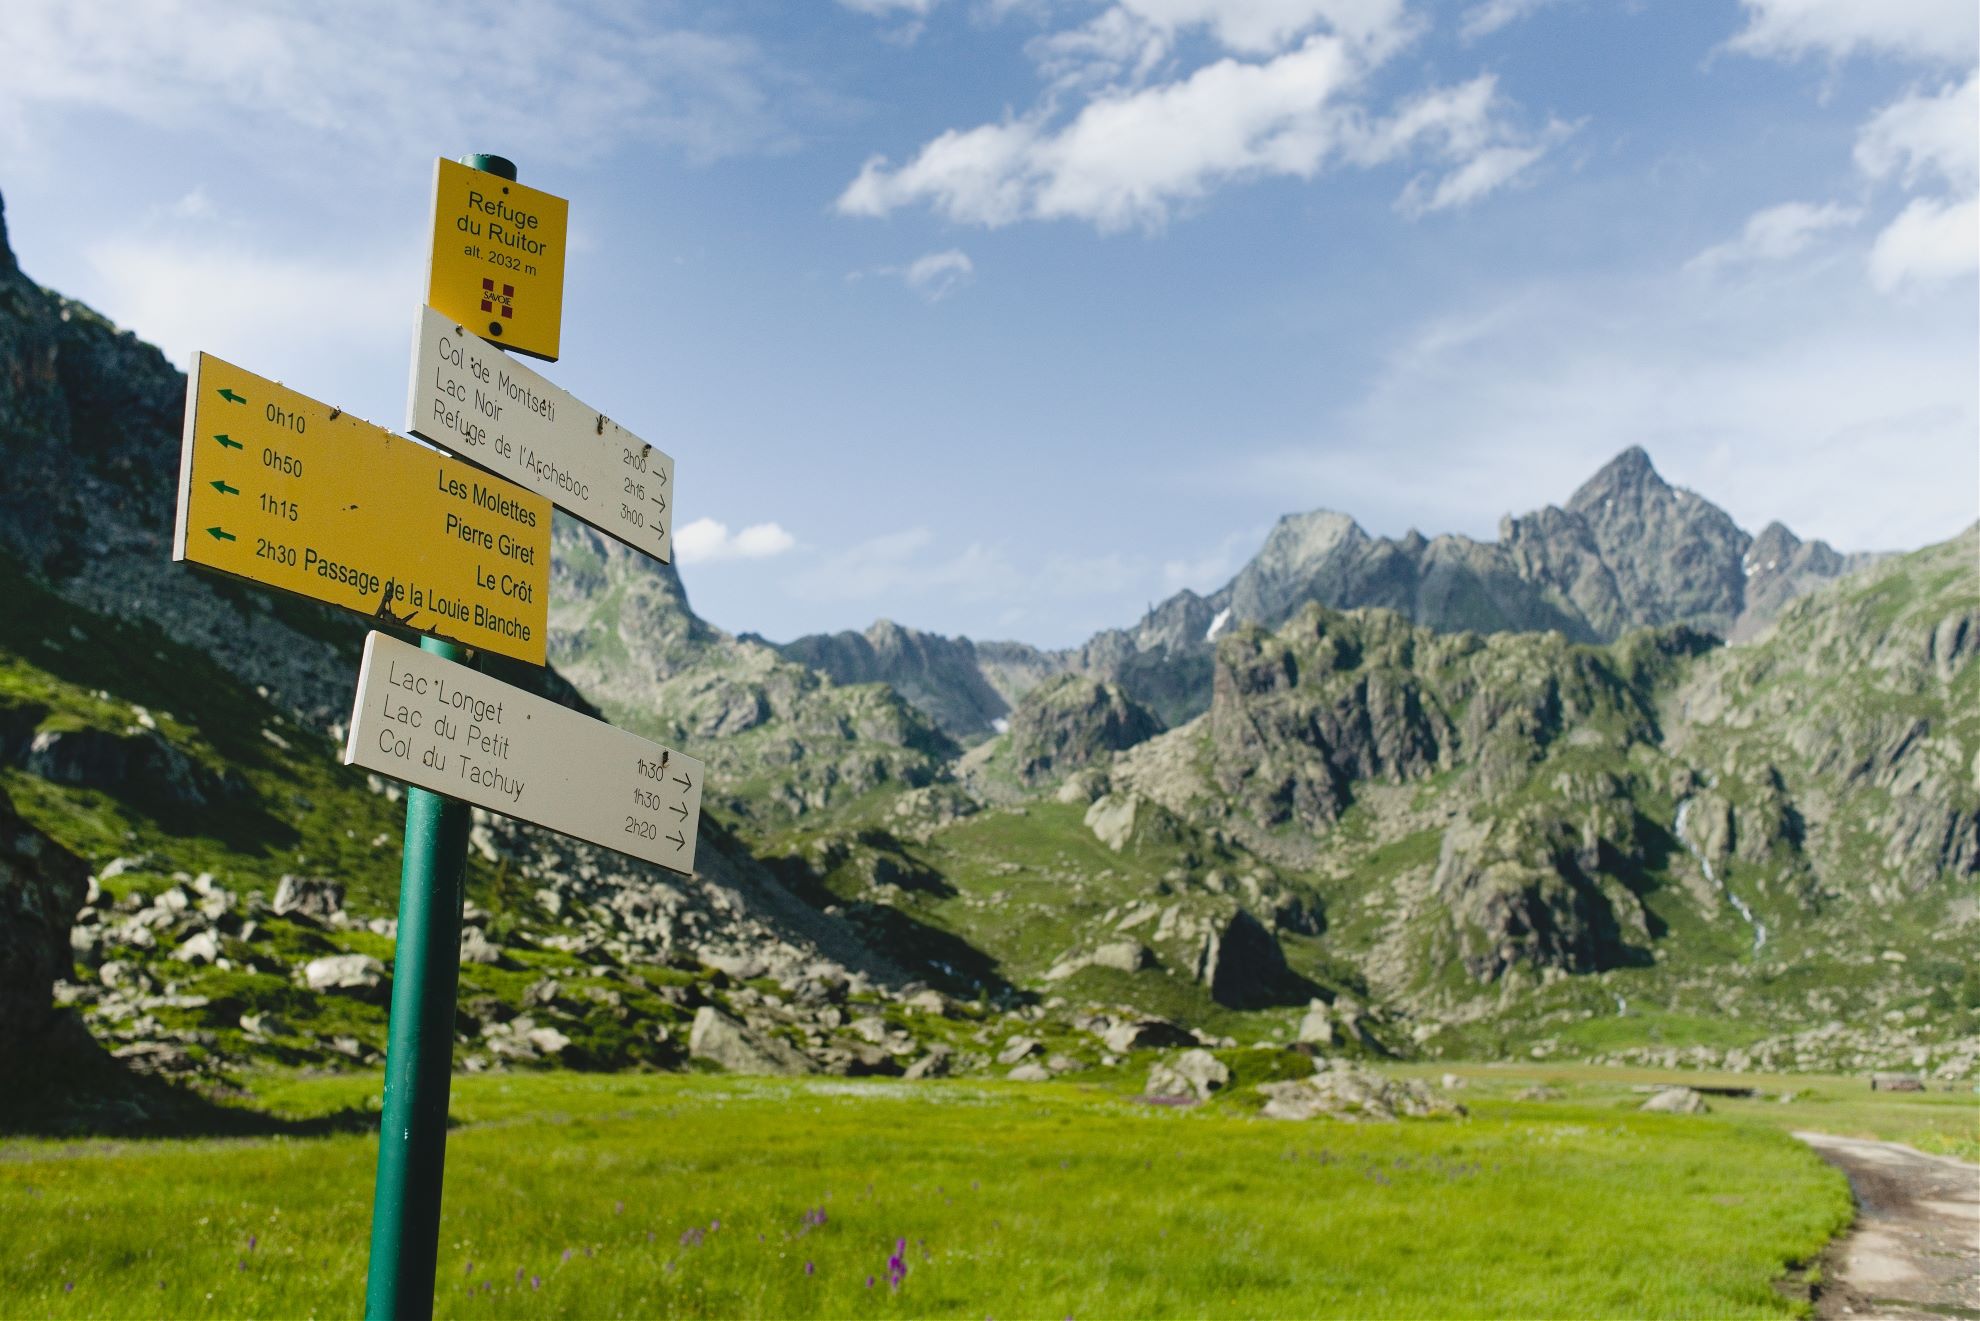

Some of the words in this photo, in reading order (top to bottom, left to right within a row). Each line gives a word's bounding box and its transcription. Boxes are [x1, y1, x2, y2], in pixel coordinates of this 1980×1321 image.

[457, 214, 481, 236] du
[488, 224, 547, 256] Ruitor
[464, 244, 484, 260] alt.
[488, 251, 521, 272] 2032
[525, 264, 538, 277] m
[469, 190, 539, 229] Refuge
[483, 291, 512, 306] SAVOIE
[433, 398, 486, 446] Refuge
[494, 434, 512, 460] de
[620, 503, 644, 529] 3h00
[436, 366, 466, 402] Lac
[475, 388, 504, 422] Noir
[624, 477, 646, 501] 2h15
[439, 338, 464, 370] Col
[473, 358, 490, 384] de
[623, 448, 647, 474] 2h00
[262, 448, 303, 478] 0h50
[446, 513, 494, 550] Pierre
[498, 534, 535, 566] Giret
[266, 403, 305, 434] 0h10
[438, 468, 468, 500] Les
[473, 483, 536, 528] Molettes
[256, 538, 297, 567] 2h30
[304, 548, 380, 596] Passage
[384, 577, 405, 601] de
[410, 583, 424, 607] la
[428, 589, 470, 621] Louie
[474, 604, 531, 642] Blanche
[259, 493, 298, 522] 1h15
[477, 565, 496, 590] Le
[501, 580, 533, 604] Crôt
[384, 694, 423, 728] Lac
[434, 714, 457, 741] du
[468, 724, 510, 760] Petit
[634, 788, 661, 811] 1h30
[389, 660, 428, 695] Lac
[438, 680, 503, 724] Longet
[637, 758, 664, 782] 1h30
[378, 728, 410, 760] Col
[423, 749, 446, 772] du
[460, 754, 525, 803] Tachuy
[624, 816, 658, 841] 2h20
